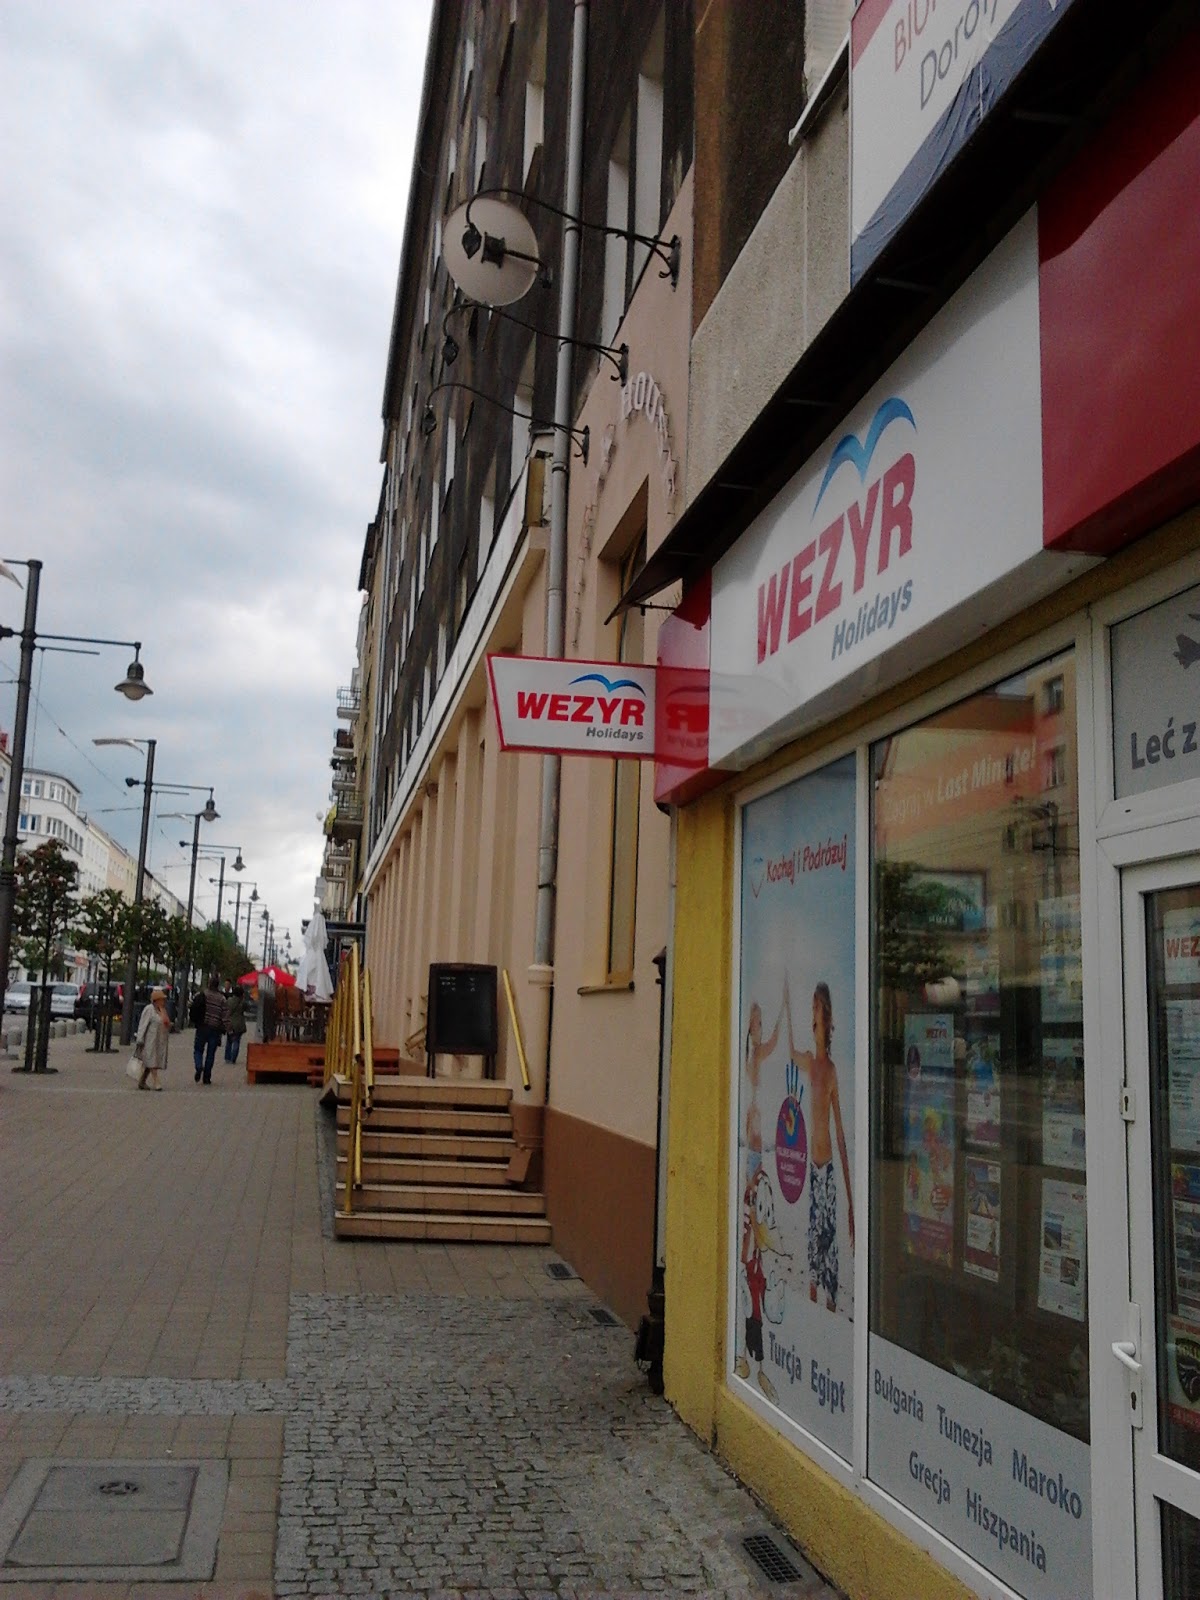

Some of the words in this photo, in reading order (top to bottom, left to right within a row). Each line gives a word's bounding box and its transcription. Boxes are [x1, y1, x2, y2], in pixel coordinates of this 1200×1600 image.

[895, 0, 936, 72] BIU
[757, 453, 915, 664] WEZYR
[831, 579, 913, 661] Holidays
[517, 691, 646, 726] WEZYR
[586, 727, 644, 741] Holidays
[1131, 717, 1175, 769] Leć
[937, 768, 969, 803] Last
[769, 1331, 801, 1384] Turcja
[811, 1360, 845, 1414] Egipt
[937, 1404, 993, 1467] Tunezja
[1012, 1448, 1083, 1519] Maroko
[909, 1451, 950, 1504] Grecja
[966, 1488, 1047, 1573] Hiszpania
